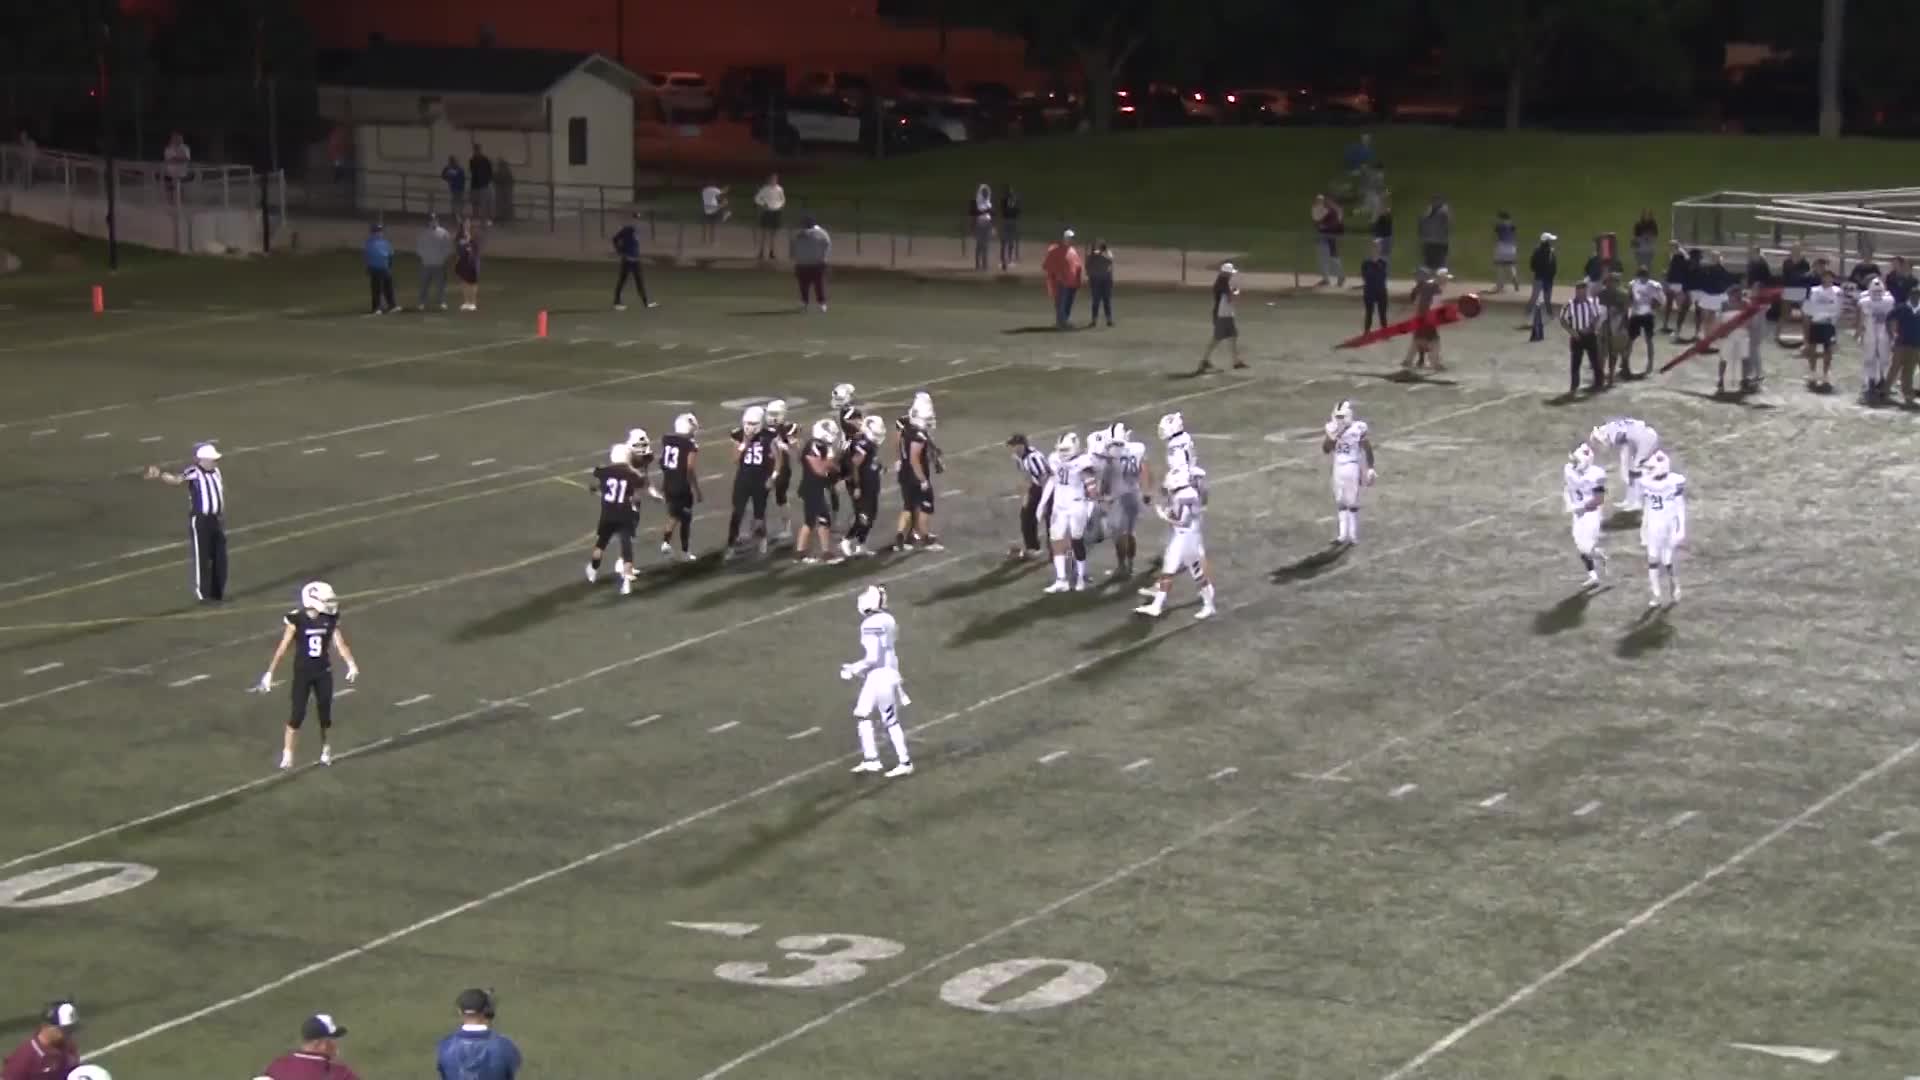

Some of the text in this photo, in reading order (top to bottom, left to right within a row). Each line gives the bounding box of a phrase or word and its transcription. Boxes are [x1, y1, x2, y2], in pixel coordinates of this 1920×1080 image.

[663, 445, 680, 468] 13
[604, 477, 628, 503] 31
[308, 635, 322, 658] 9
